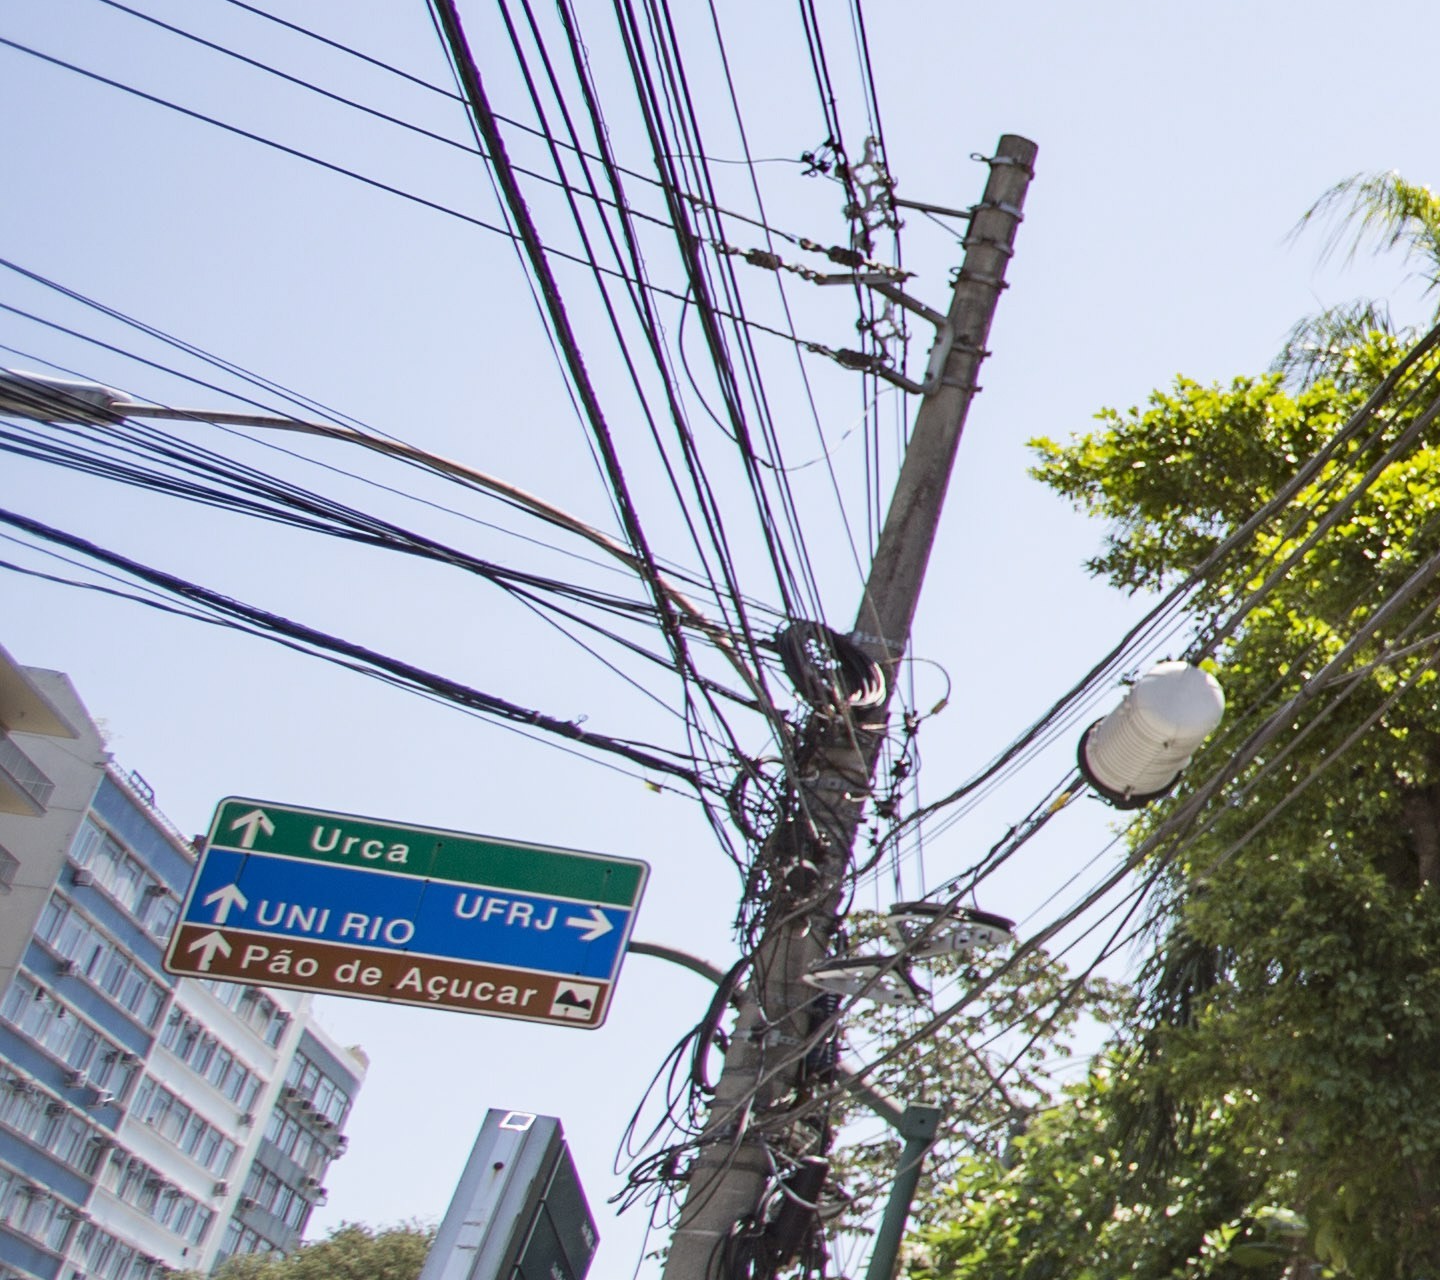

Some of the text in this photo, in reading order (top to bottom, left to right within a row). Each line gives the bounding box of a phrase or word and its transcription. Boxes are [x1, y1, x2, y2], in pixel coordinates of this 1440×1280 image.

[310, 825, 410, 864] Urca
[255, 900, 416, 945] UNI RIO
[454, 893, 559, 931] UFRJ
[241, 944, 539, 1006] Pão de Açucar
